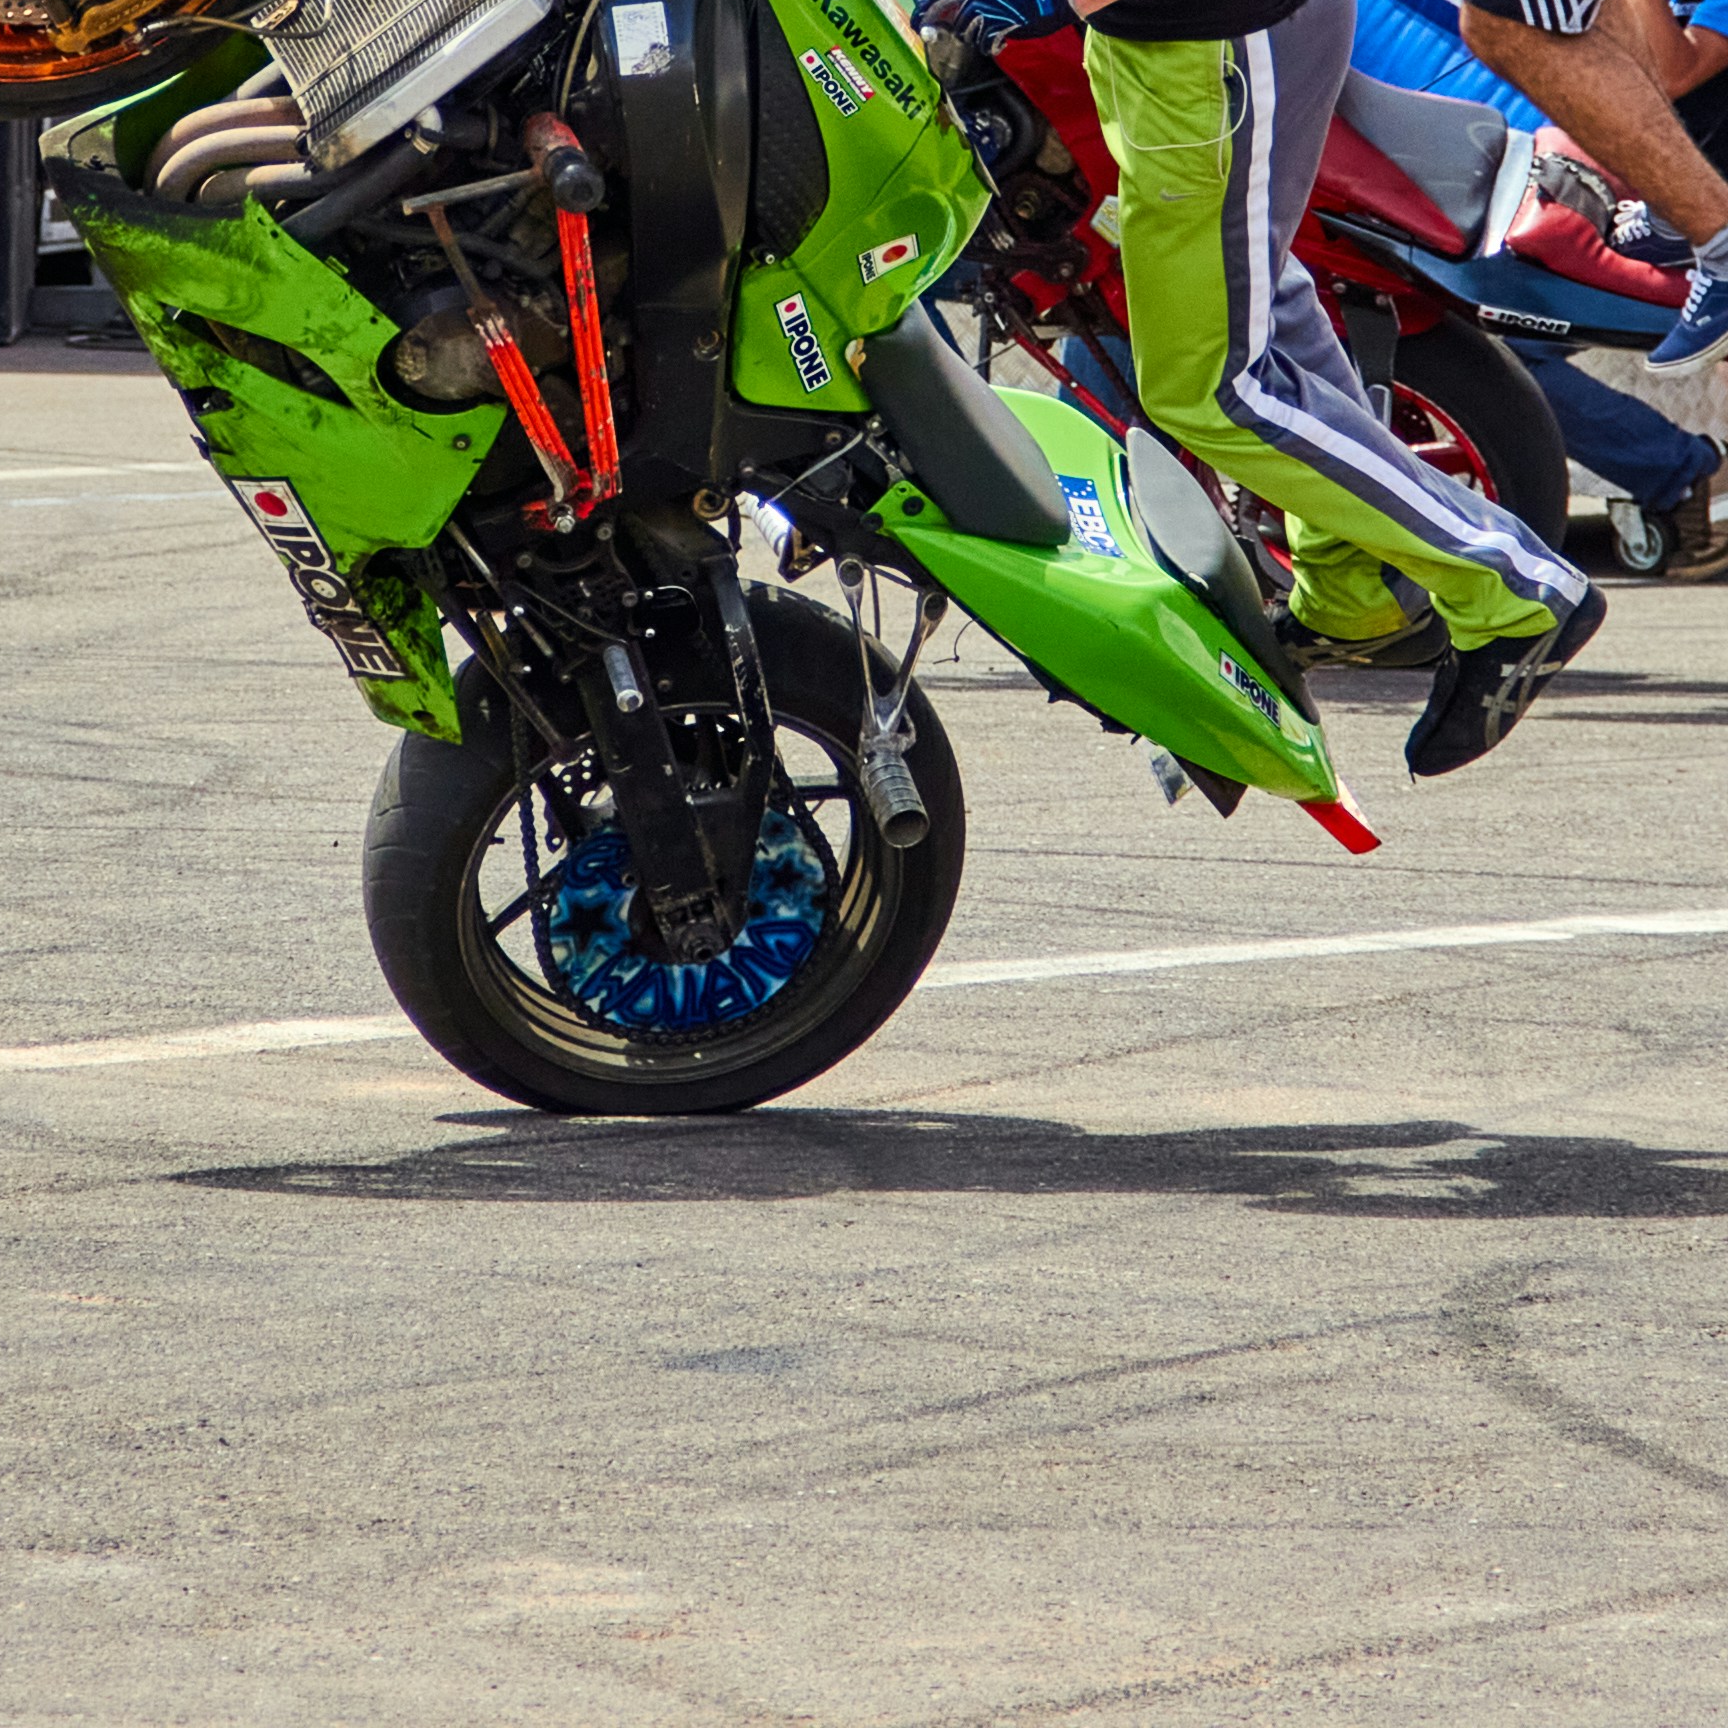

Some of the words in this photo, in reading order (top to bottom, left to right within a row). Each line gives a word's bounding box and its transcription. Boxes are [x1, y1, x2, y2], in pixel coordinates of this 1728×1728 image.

[810, 63, 858, 116] IPONE
[830, 46, 873, 95] KENNY
[1498, 312, 1568, 333] IPONE
[783, 312, 830, 390] IPONE
[1068, 496, 1116, 548] EBC
[262, 524, 403, 673] IPONE
[1235, 665, 1280, 726] IPONE
